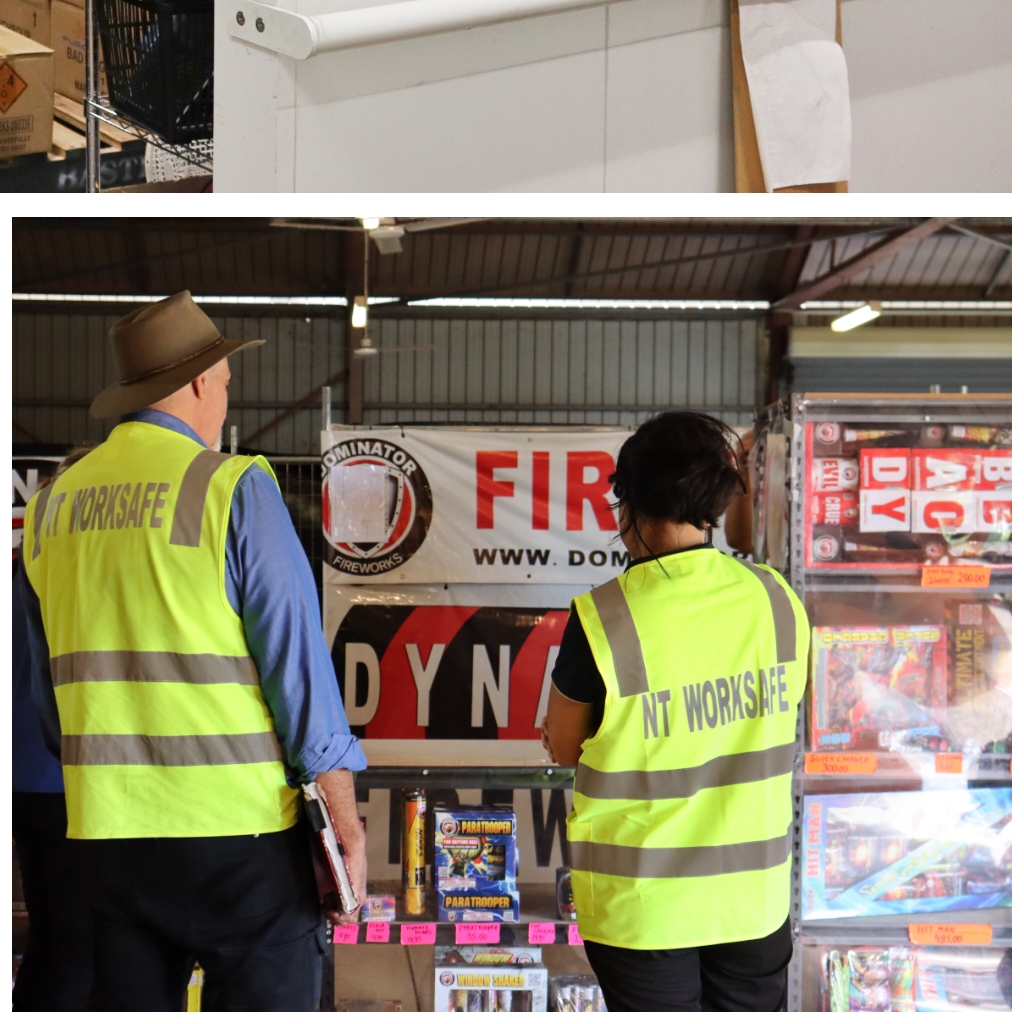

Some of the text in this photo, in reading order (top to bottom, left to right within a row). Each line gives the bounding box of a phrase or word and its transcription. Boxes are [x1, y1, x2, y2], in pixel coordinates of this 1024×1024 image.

[66, 47, 84, 65] BAD
[9, 144, 26, 152] AWAY
[823, 460, 839, 489] EVIL
[45, 482, 171, 538] NT WORKSAFE
[332, 552, 404, 575] FIREWORKS
[956, 629, 972, 705] LTIMATE
[642, 665, 789, 740] NT WORKSAFE
[809, 754, 869, 764] SUPER CHARGED
[461, 821, 512, 834] PARATROOPER
[806, 803, 823, 877] HIT MAN
[445, 896, 510, 908] PARATROOPER
[457, 973, 525, 987] WINDOW SHAKER
